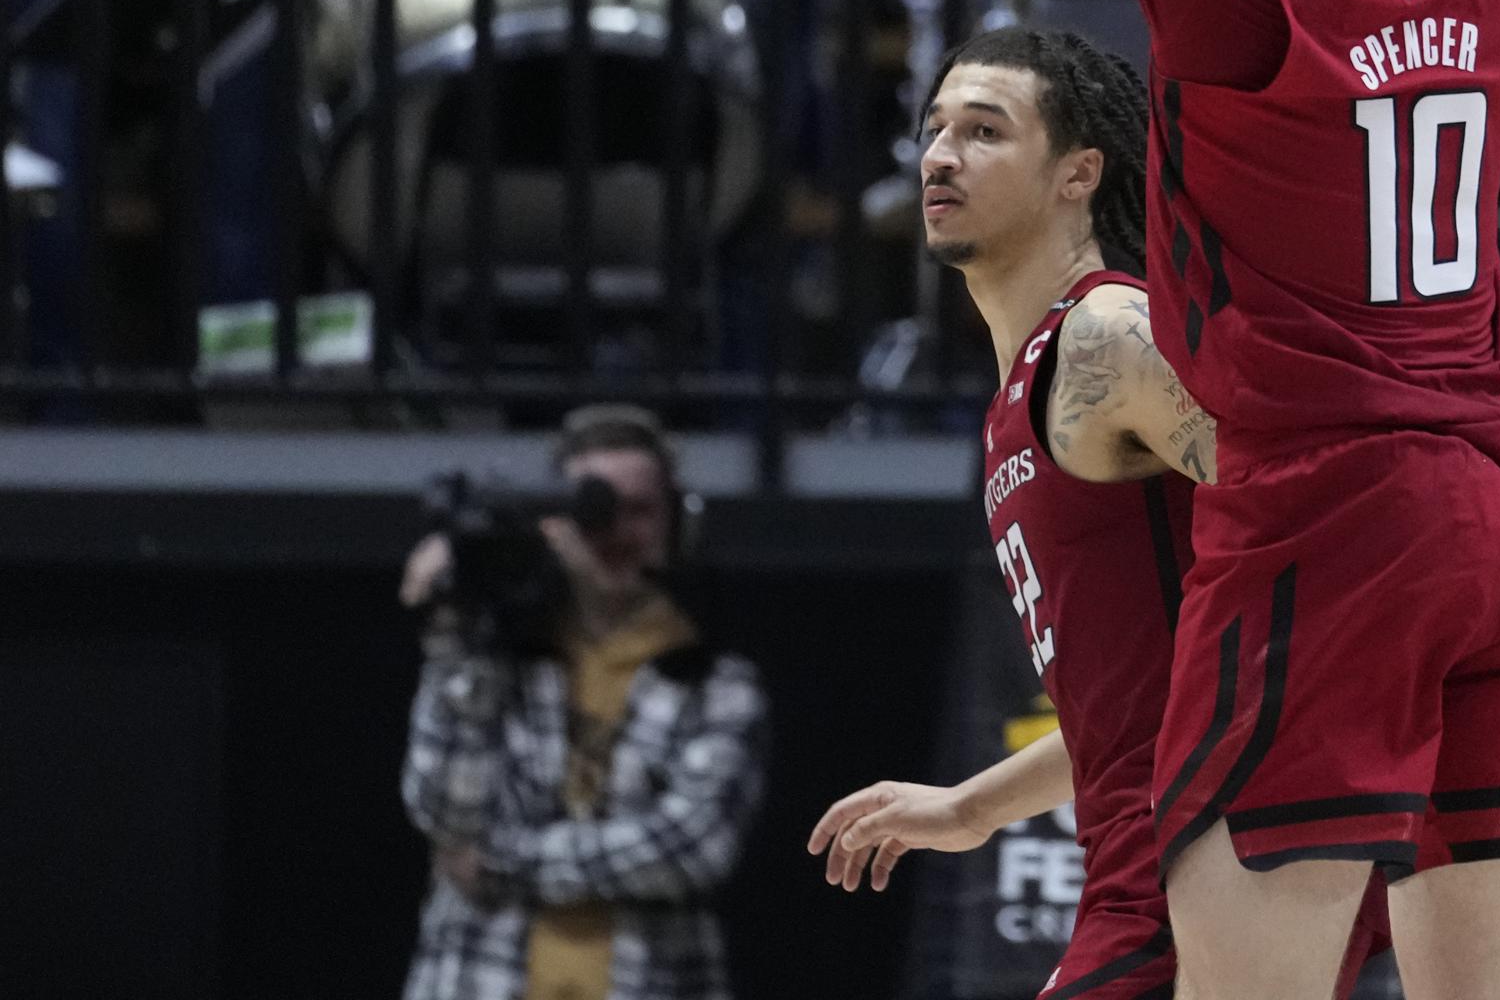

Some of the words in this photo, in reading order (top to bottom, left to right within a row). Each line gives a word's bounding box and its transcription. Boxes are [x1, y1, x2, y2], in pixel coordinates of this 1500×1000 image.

[1349, 17, 1479, 91] SPENCER
[1354, 89, 1488, 304] 10
[998, 837, 1088, 905] FE
